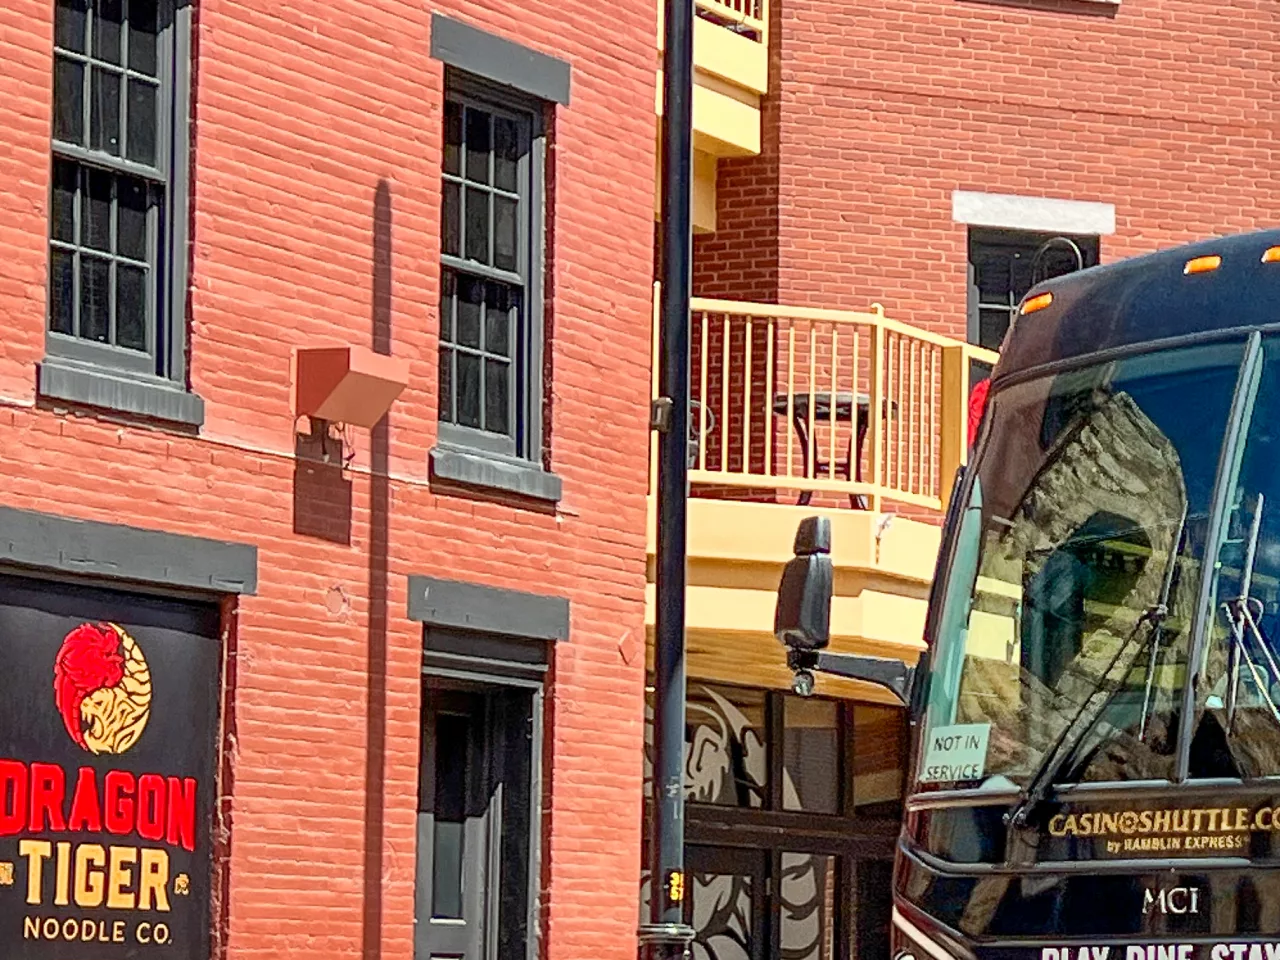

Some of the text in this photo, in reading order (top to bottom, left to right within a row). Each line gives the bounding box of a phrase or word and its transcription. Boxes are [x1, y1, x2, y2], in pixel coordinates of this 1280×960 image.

[933, 734, 980, 752] NOT IN
[925, 763, 980, 780] SERVICE
[0, 759, 197, 851] DRAGON
[1185, 834, 1241, 850] EXPRESS
[19, 839, 171, 912] TIGER
[1142, 887, 1199, 914] MCI
[24, 916, 172, 945] NOODLE CO.
